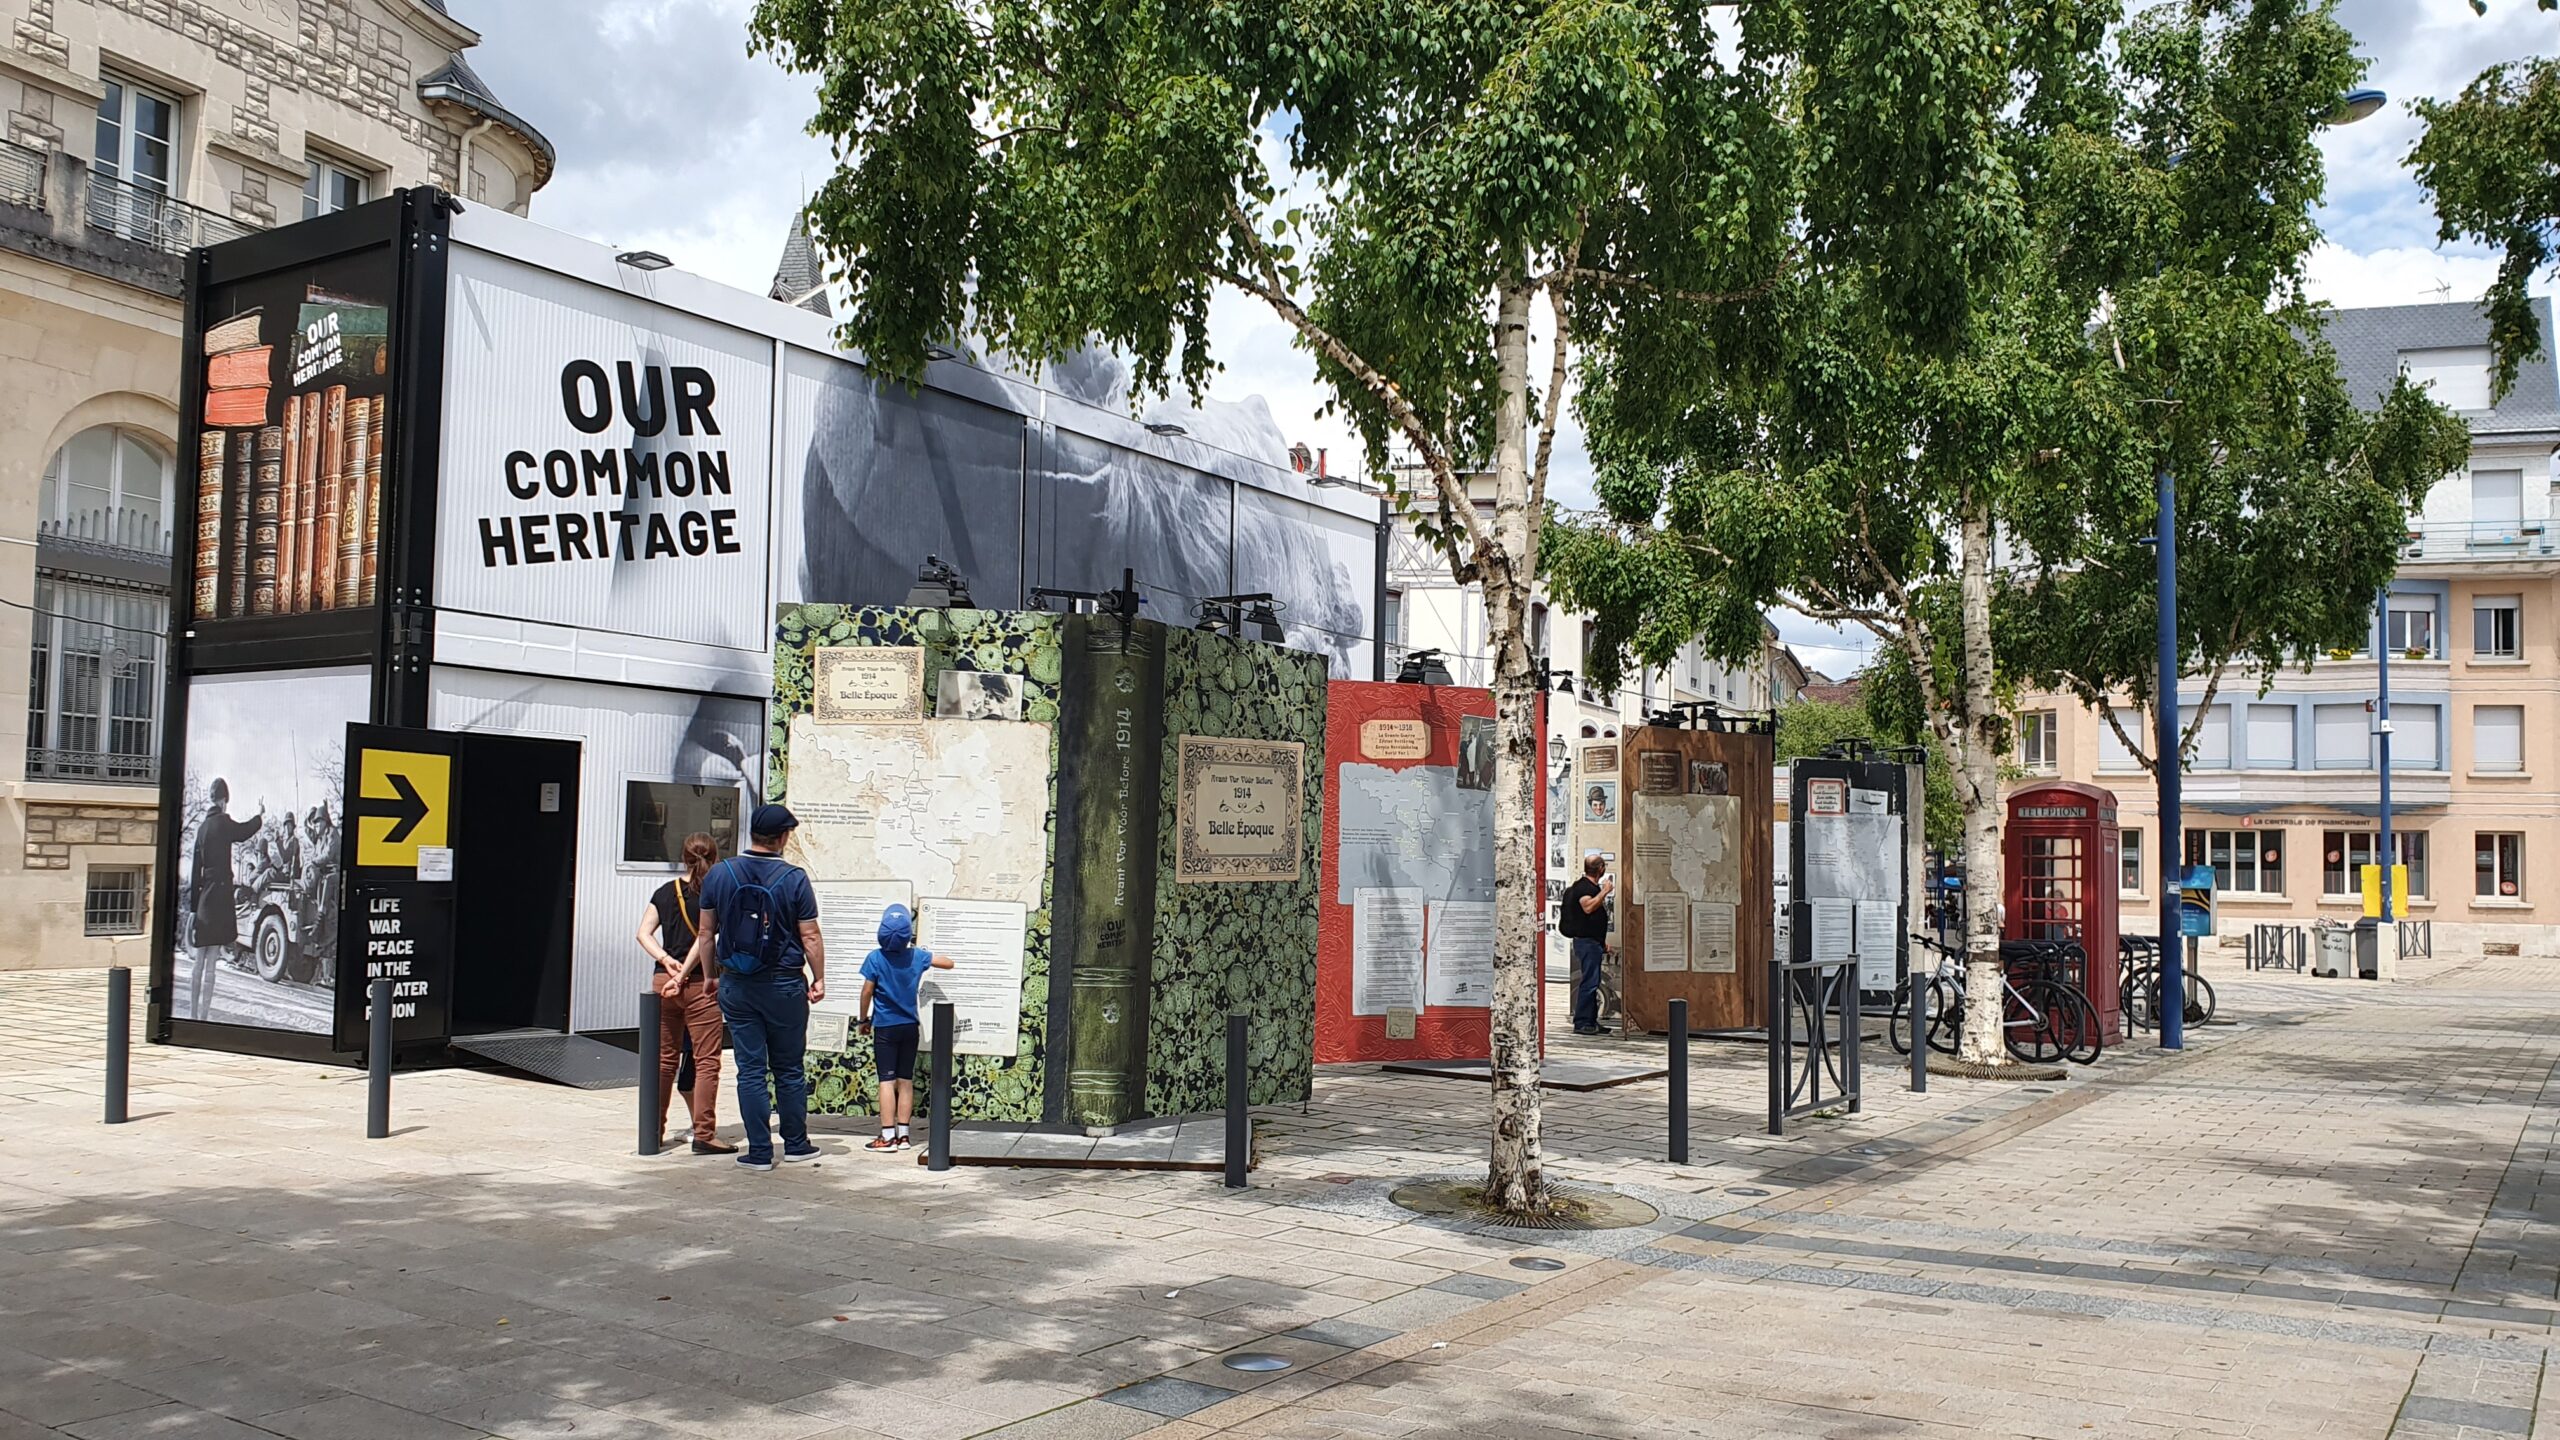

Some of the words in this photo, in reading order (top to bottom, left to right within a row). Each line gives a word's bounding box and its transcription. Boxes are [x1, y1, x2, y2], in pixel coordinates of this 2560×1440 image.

[307, 312, 339, 344] OUR
[297, 333, 341, 367] COMMON
[293, 348, 343, 387] HERITAGE
[561, 359, 721, 437] OUR
[505, 448, 731, 500] COMMON
[478, 509, 741, 567] HERITAGE
[840, 691, 863, 700] Belle
[864, 689, 898, 701] Époque
[1116, 707, 1132, 751] 1914
[1119, 755, 1131, 800] Before
[1233, 787, 1252, 799] 1914
[2021, 807, 2086, 817] TELEPHONE
[1208, 820, 1236, 836] Belle
[1237, 818, 1275, 838] Époque
[1116, 839, 1127, 866] Vor
[1114, 868, 1125, 907] Avant
[370, 898, 400, 913] LIFE
[369, 919, 401, 934] WAR
[368, 940, 414, 956] PEACE
[367, 962, 382, 977] IN
[384, 961, 411, 977] THE
[366, 981, 428, 999] GATER
[365, 1003, 415, 1021] RION
